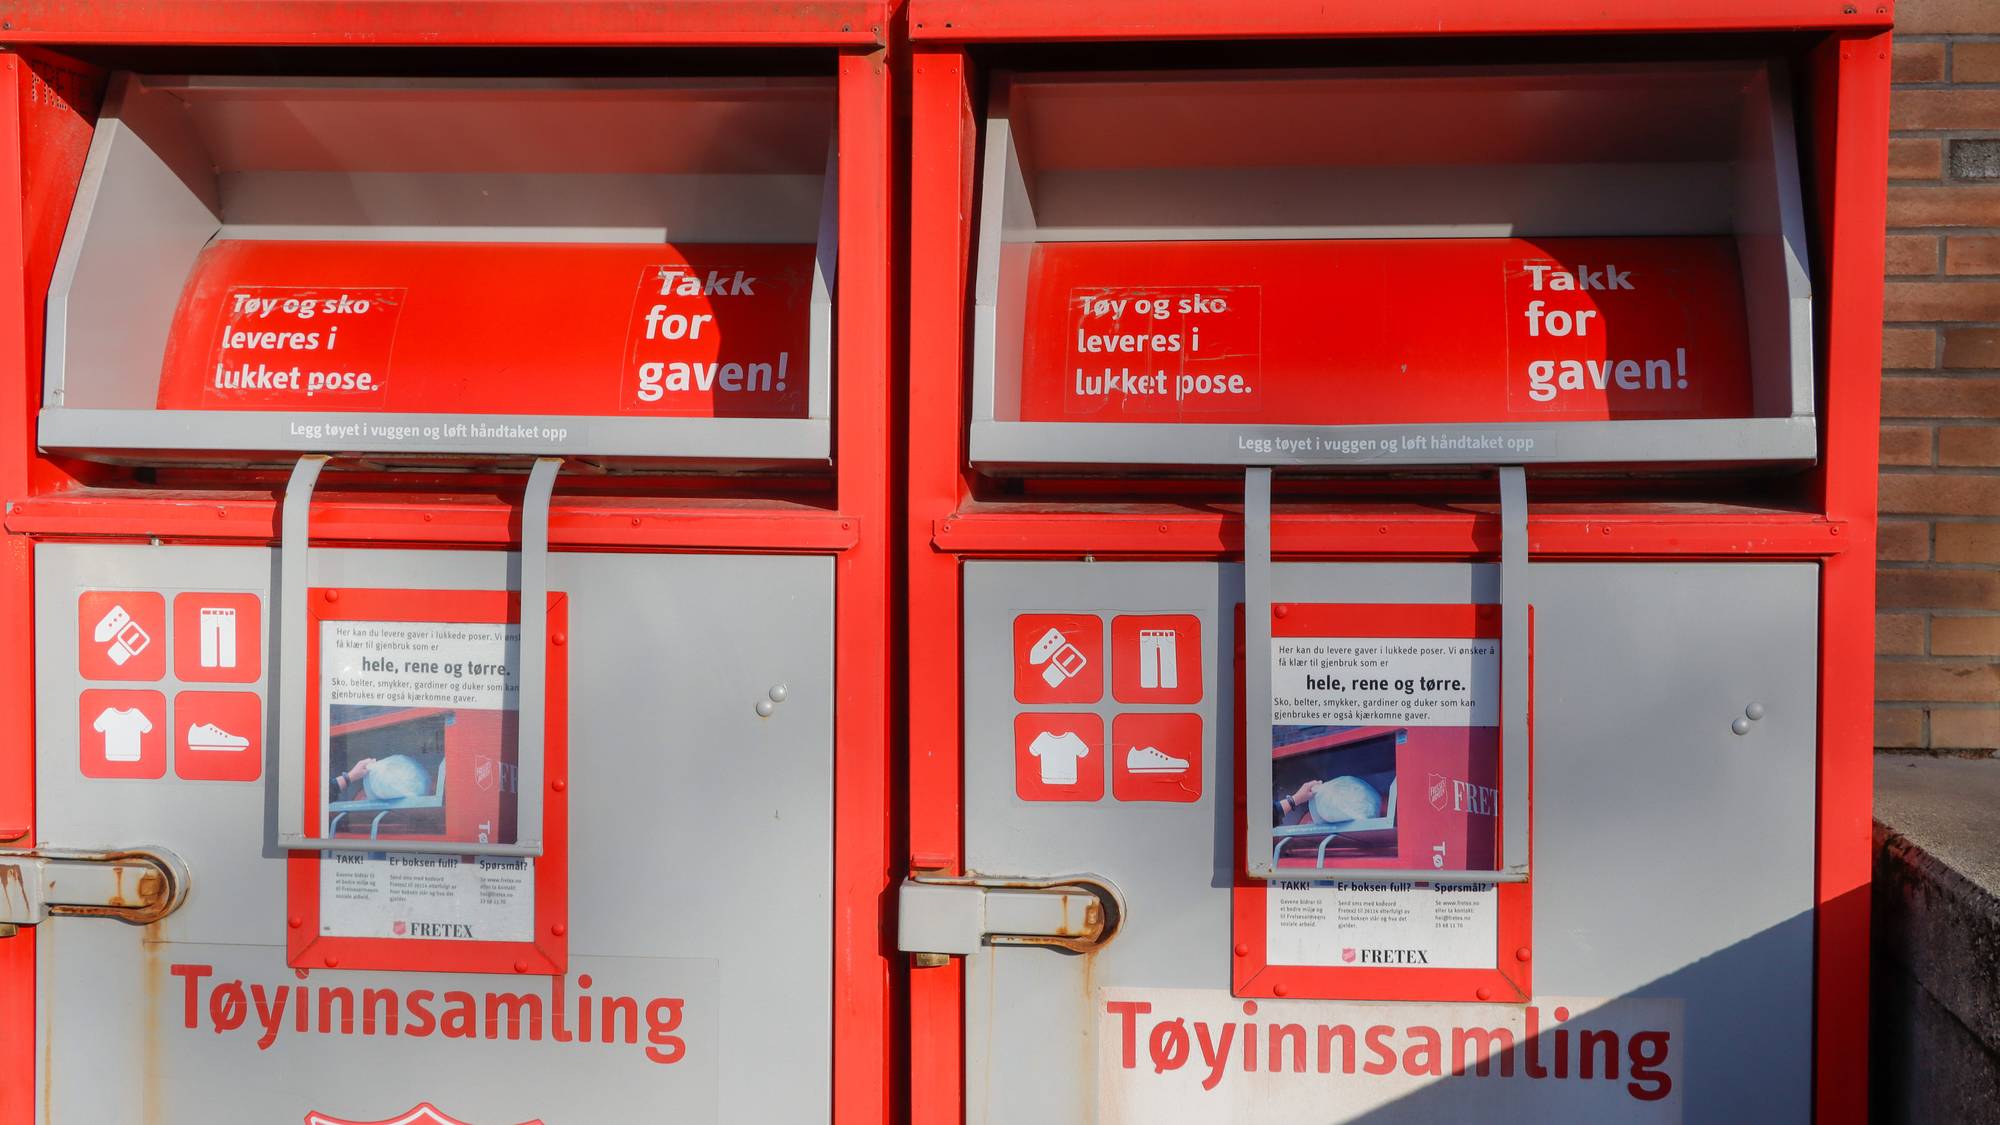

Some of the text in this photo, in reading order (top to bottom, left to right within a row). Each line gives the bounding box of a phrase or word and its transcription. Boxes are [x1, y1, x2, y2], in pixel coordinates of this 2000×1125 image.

[657, 270, 753, 296] Takk
[1522, 264, 1633, 291] Takk
[230, 293, 369, 319] Tøy og sko
[1077, 294, 1226, 320] Tøy og sko
[645, 304, 712, 340] for
[1524, 300, 1596, 336] for
[221, 324, 337, 352] leveres i
[1077, 326, 1198, 352] leveres i
[214, 362, 378, 396] lukket pose.
[637, 352, 787, 402] gaven!
[1075, 367, 1251, 401] lukket pose.
[1527, 348, 1687, 406] gaven!
[288, 420, 567, 442] Legg tøyet i vuggen og løft håndtaket opp
[1238, 433, 1534, 453] Legg tøyet i vuggen og løft håndtaket opp
[336, 627, 350, 636] Her
[352, 627, 366, 637] kan
[368, 628, 378, 637] du
[381, 628, 404, 641] levere
[406, 631, 429, 640] gaver
[430, 630, 433, 638] i
[435, 630, 466, 640] lukkede
[468, 631, 492, 642] poser.
[494, 632, 501, 640] Vi
[335, 639, 438, 652] få klær til gjenbruk som er
[1278, 645, 1494, 656] Her kan du levere gaver i lukkede poser. Vi ønsker å
[362, 655, 512, 680] hele, rene og tørre.
[1278, 657, 1286, 666] få
[1289, 657, 1307, 667] klær
[1309, 658, 1318, 666] til
[1320, 658, 1357, 668] gjenbruk
[1359, 658, 1377, 667] som
[331, 677, 347, 688] Sko,
[350, 677, 375, 688] belter,
[377, 678, 412, 690] smykker,
[414, 680, 448, 691] gardiner
[450, 682, 460, 692] og
[462, 681, 483, 690] duker
[504, 682, 518, 691] kan
[1306, 674, 1465, 694] hele, rene og tørre.
[331, 689, 477, 704] gjenbrukes er også kjærkomne gaver.
[1273, 697, 1291, 706] Sko,
[1293, 697, 1320, 706] belter,
[1323, 698, 1360, 708] smykker,
[1363, 698, 1398, 708] gardiner
[1400, 700, 1411, 708] og
[1413, 698, 1437, 706] duker
[1460, 698, 1476, 706] kan
[1273, 710, 1320, 720] gjenbrukes
[1333, 710, 1352, 720] også
[1355, 710, 1401, 720] kjærkomne
[1404, 712, 1430, 721] gaver.
[336, 855, 364, 864] TAKK!
[389, 857, 458, 868] Er boksen full?
[480, 859, 528, 871] Spørsmål?
[1280, 881, 1310, 890] TAKK!
[1337, 882, 1411, 892] Er boksen full?
[1434, 882, 1487, 894] Spørsmål?
[410, 922, 472, 938] FRETEX
[1361, 949, 1427, 963] FRETEX
[171, 964, 686, 1064] Tøyinnsamling
[1106, 1000, 1670, 1101] Tøyinnsamling
